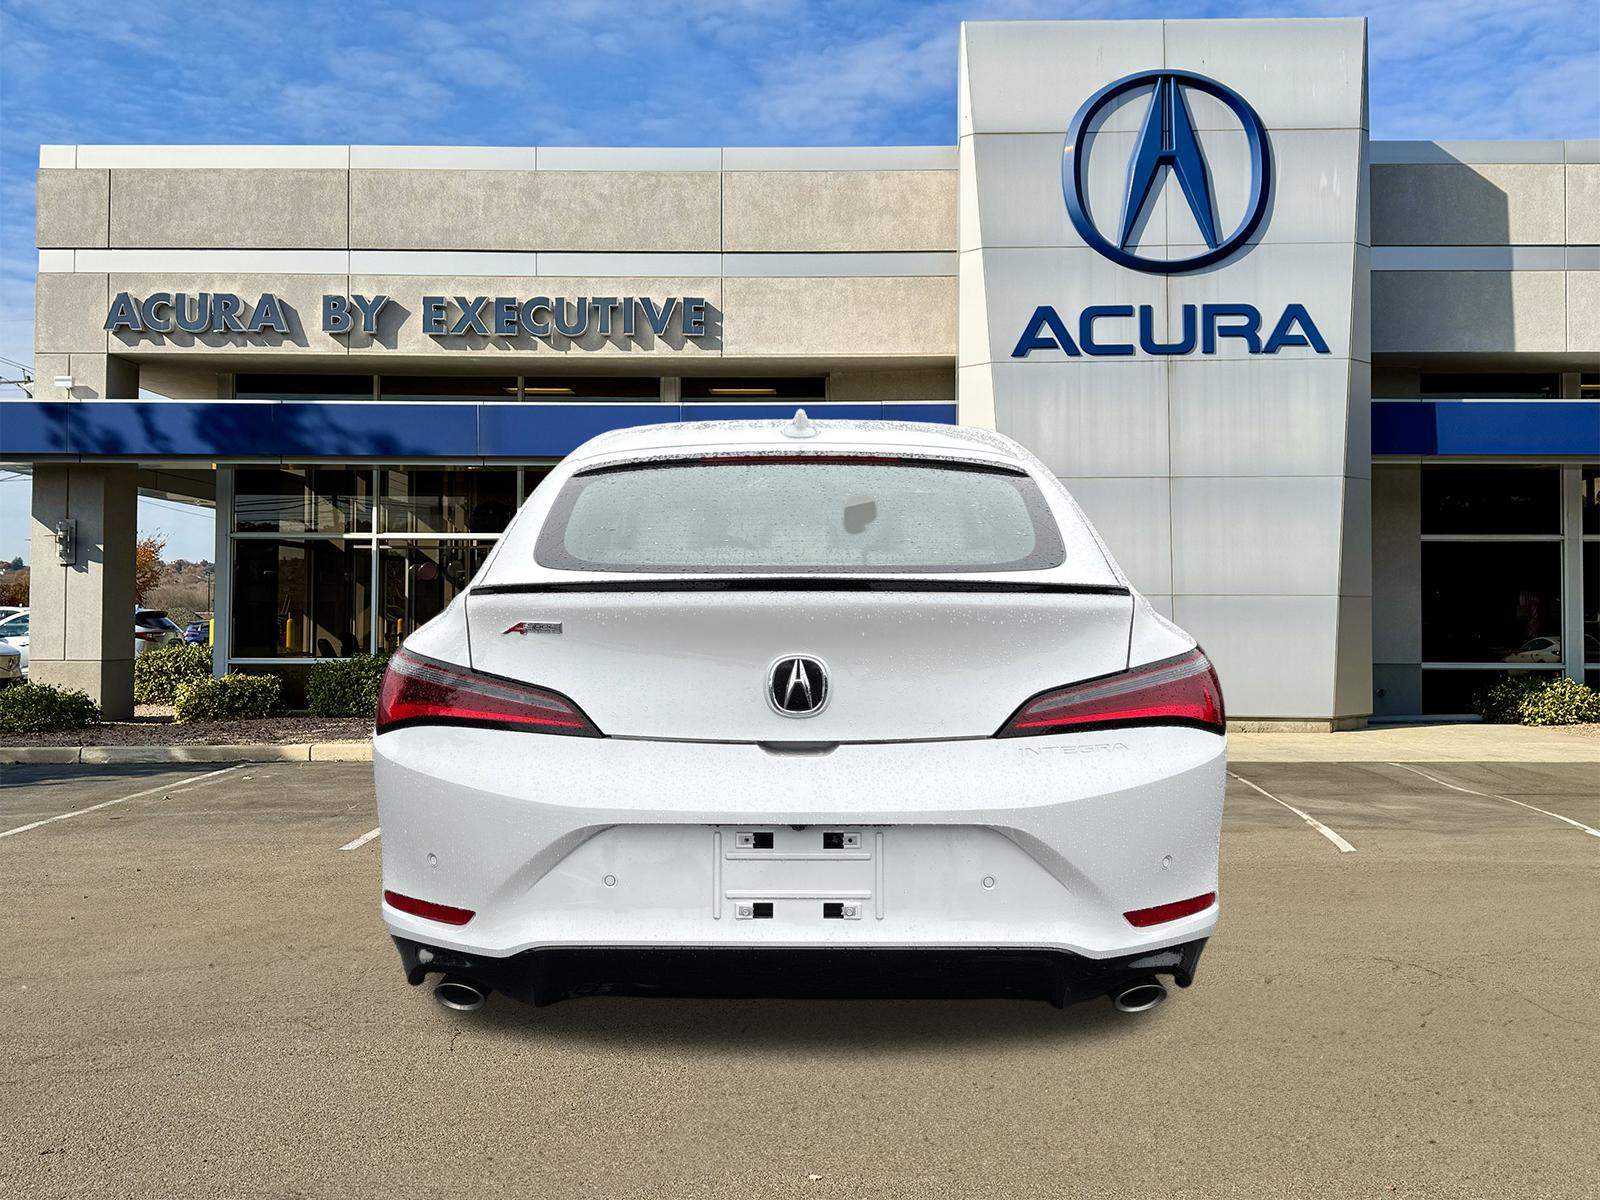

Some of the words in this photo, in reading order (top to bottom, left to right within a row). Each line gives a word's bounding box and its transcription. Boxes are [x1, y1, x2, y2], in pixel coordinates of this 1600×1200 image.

[104, 291, 288, 334] ACURA
[322, 294, 389, 334] BY
[423, 296, 706, 337] EXECUTIVE
[1011, 304, 1331, 357] ACURA
[1018, 742, 1129, 757] INTEGRA
